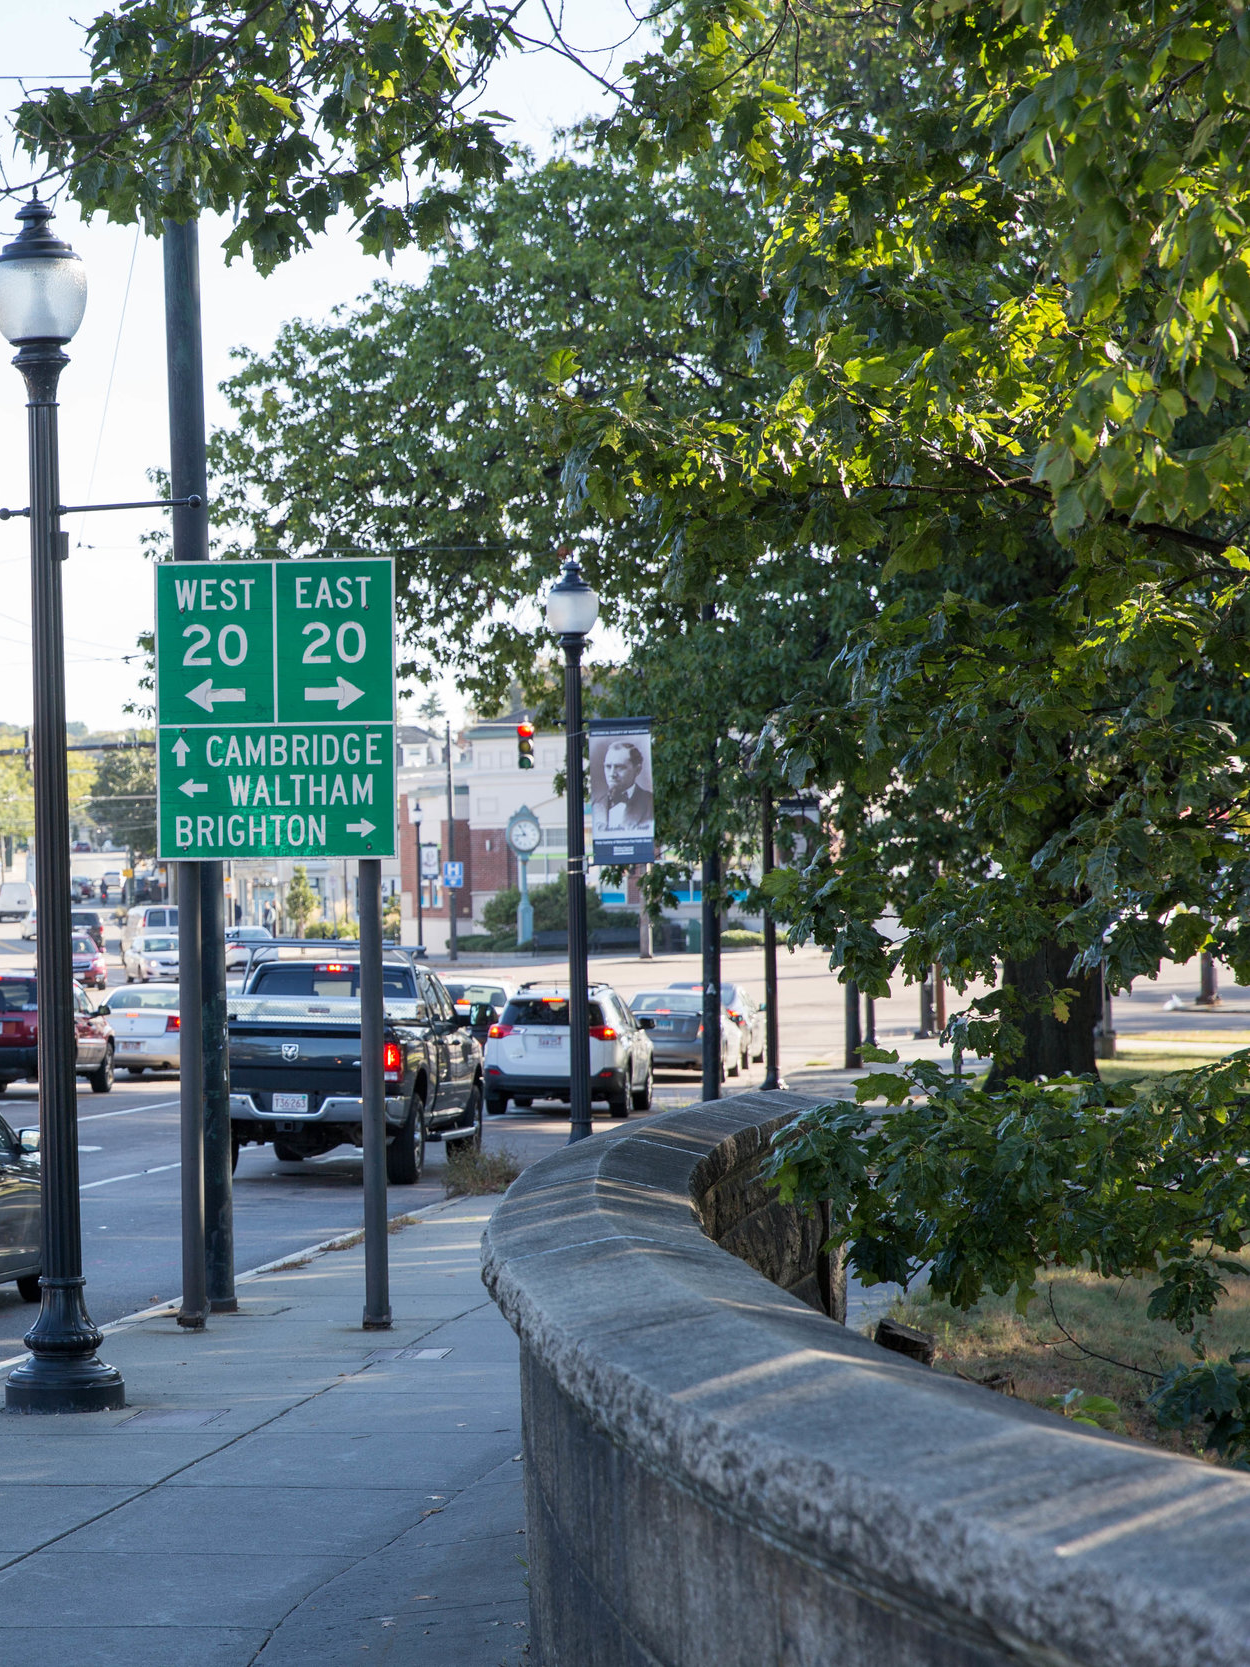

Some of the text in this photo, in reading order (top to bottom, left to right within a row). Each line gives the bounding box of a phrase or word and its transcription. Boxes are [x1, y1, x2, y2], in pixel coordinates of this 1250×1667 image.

[175, 578, 255, 611] WEST
[295, 576, 371, 609] EAST
[182, 623, 248, 666] 20
[302, 620, 367, 664] 20
[206, 733, 382, 768] CAMBRIDGE
[228, 774, 373, 807] WALTHAM
[176, 814, 327, 847] BRIGHTON
[447, 863, 460, 875] H
